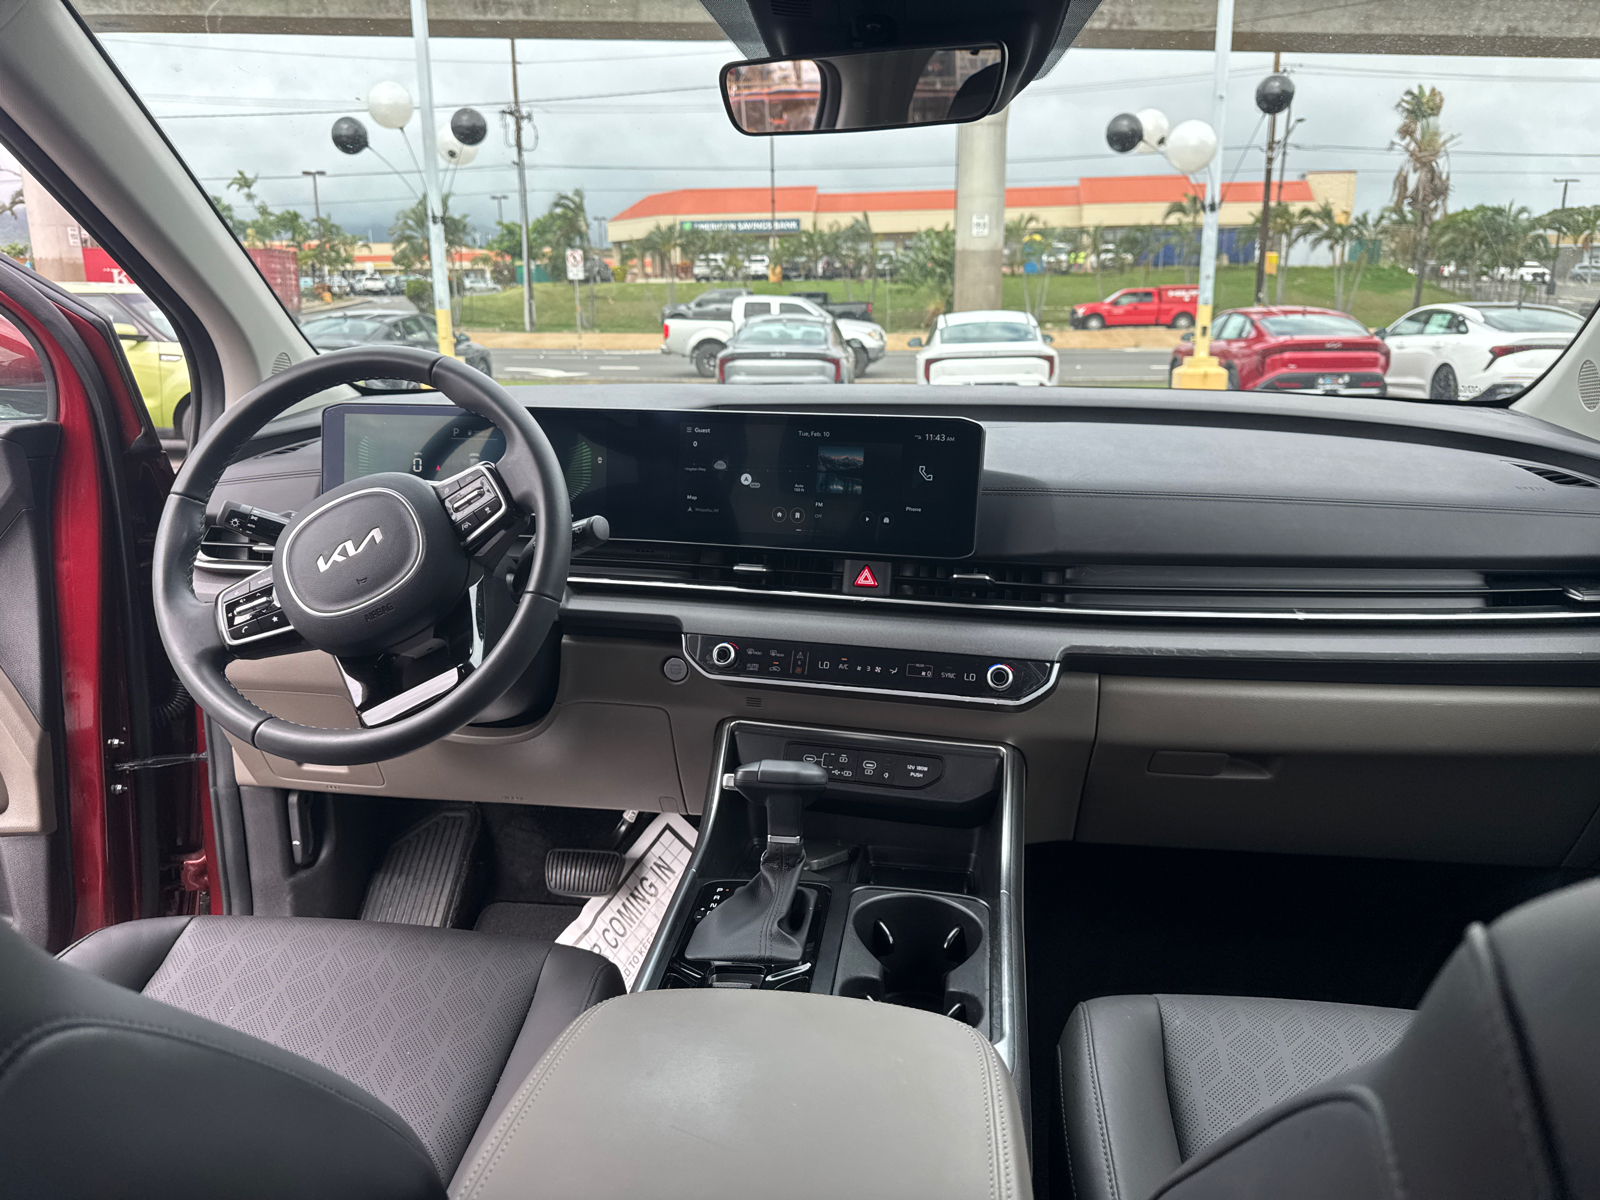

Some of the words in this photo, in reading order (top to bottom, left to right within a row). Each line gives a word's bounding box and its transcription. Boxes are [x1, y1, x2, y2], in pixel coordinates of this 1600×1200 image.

[453, 428, 460, 436] P
[694, 426, 711, 434] Guest
[925, 433, 946, 441] 11:43
[413, 458, 422, 472] 0
[364, 602, 395, 622] AIRBAG
[941, 671, 957, 679] SYNC
[964, 672, 976, 682] LO
[602, 876, 659, 949] COMING
[649, 856, 676, 885] IN
[629, 955, 640, 969] TO
